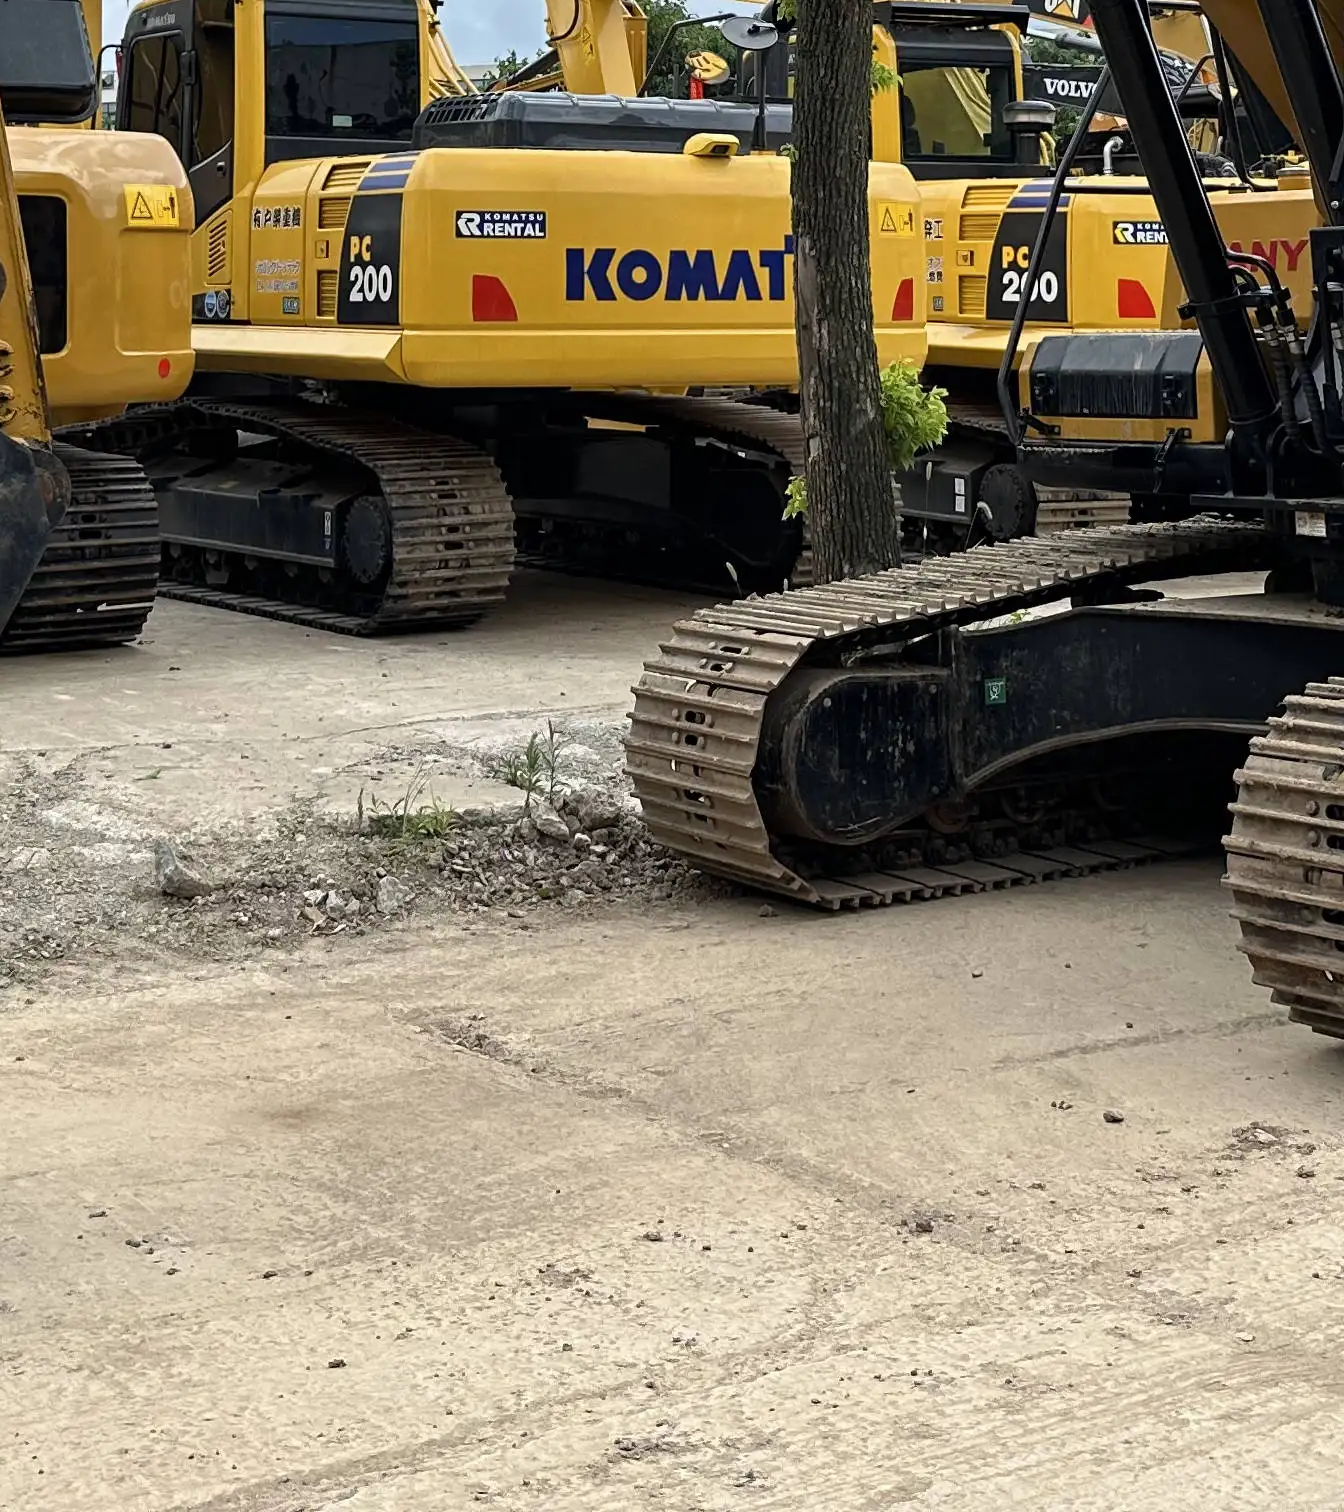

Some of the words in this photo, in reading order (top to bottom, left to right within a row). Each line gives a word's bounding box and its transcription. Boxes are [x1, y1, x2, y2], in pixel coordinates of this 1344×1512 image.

[1043, 77, 1097, 98] VOLV
[484, 212, 544, 221] KOMATSU
[483, 222, 545, 237] RENTAL
[349, 235, 372, 262] PC
[1001, 245, 1030, 269] PC
[1227, 239, 1309, 272] ANY
[565, 234, 795, 301] KOMAT
[348, 264, 393, 302] 200
